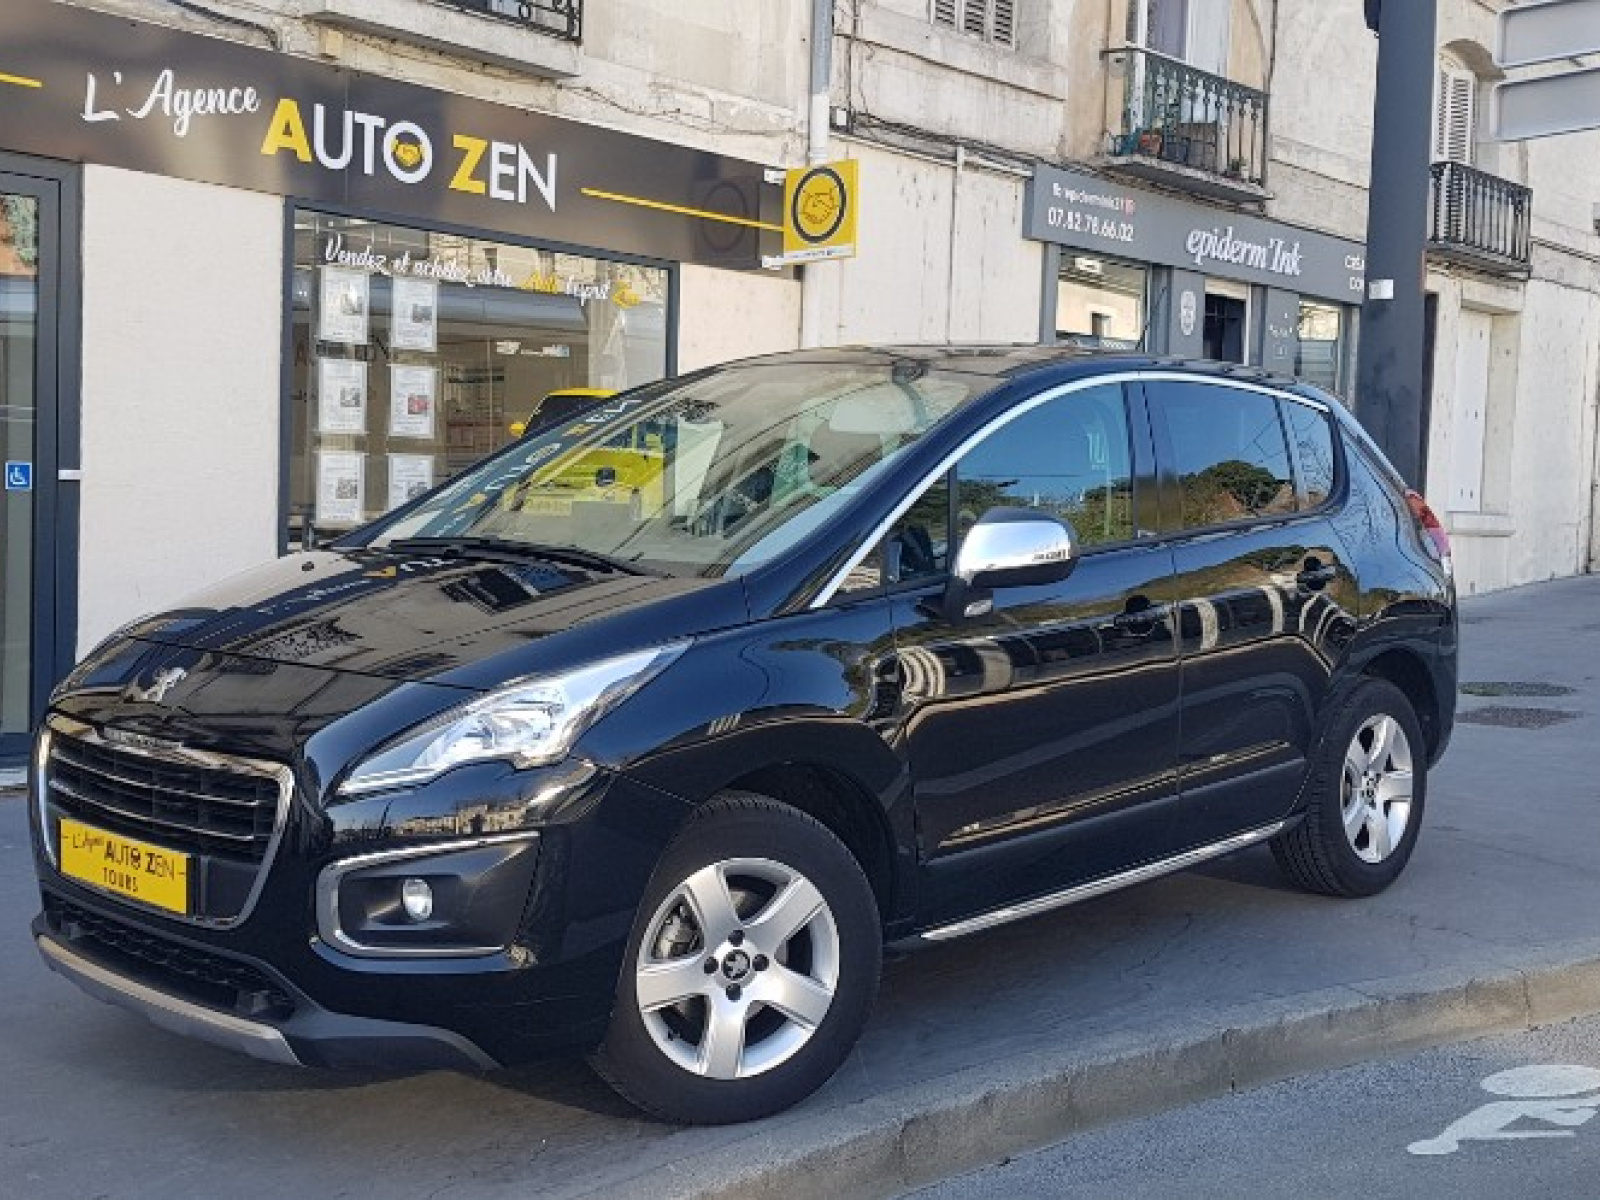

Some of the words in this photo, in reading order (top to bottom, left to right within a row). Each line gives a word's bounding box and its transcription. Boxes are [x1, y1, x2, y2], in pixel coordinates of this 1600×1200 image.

[261, 98, 433, 184] AUTO
[448, 134, 557, 212] ZEN
[325, 233, 392, 275] Vendez
[102, 866, 139, 892] TOURS
[104, 840, 141, 870] AUTO
[145, 852, 175, 880] ZEN
